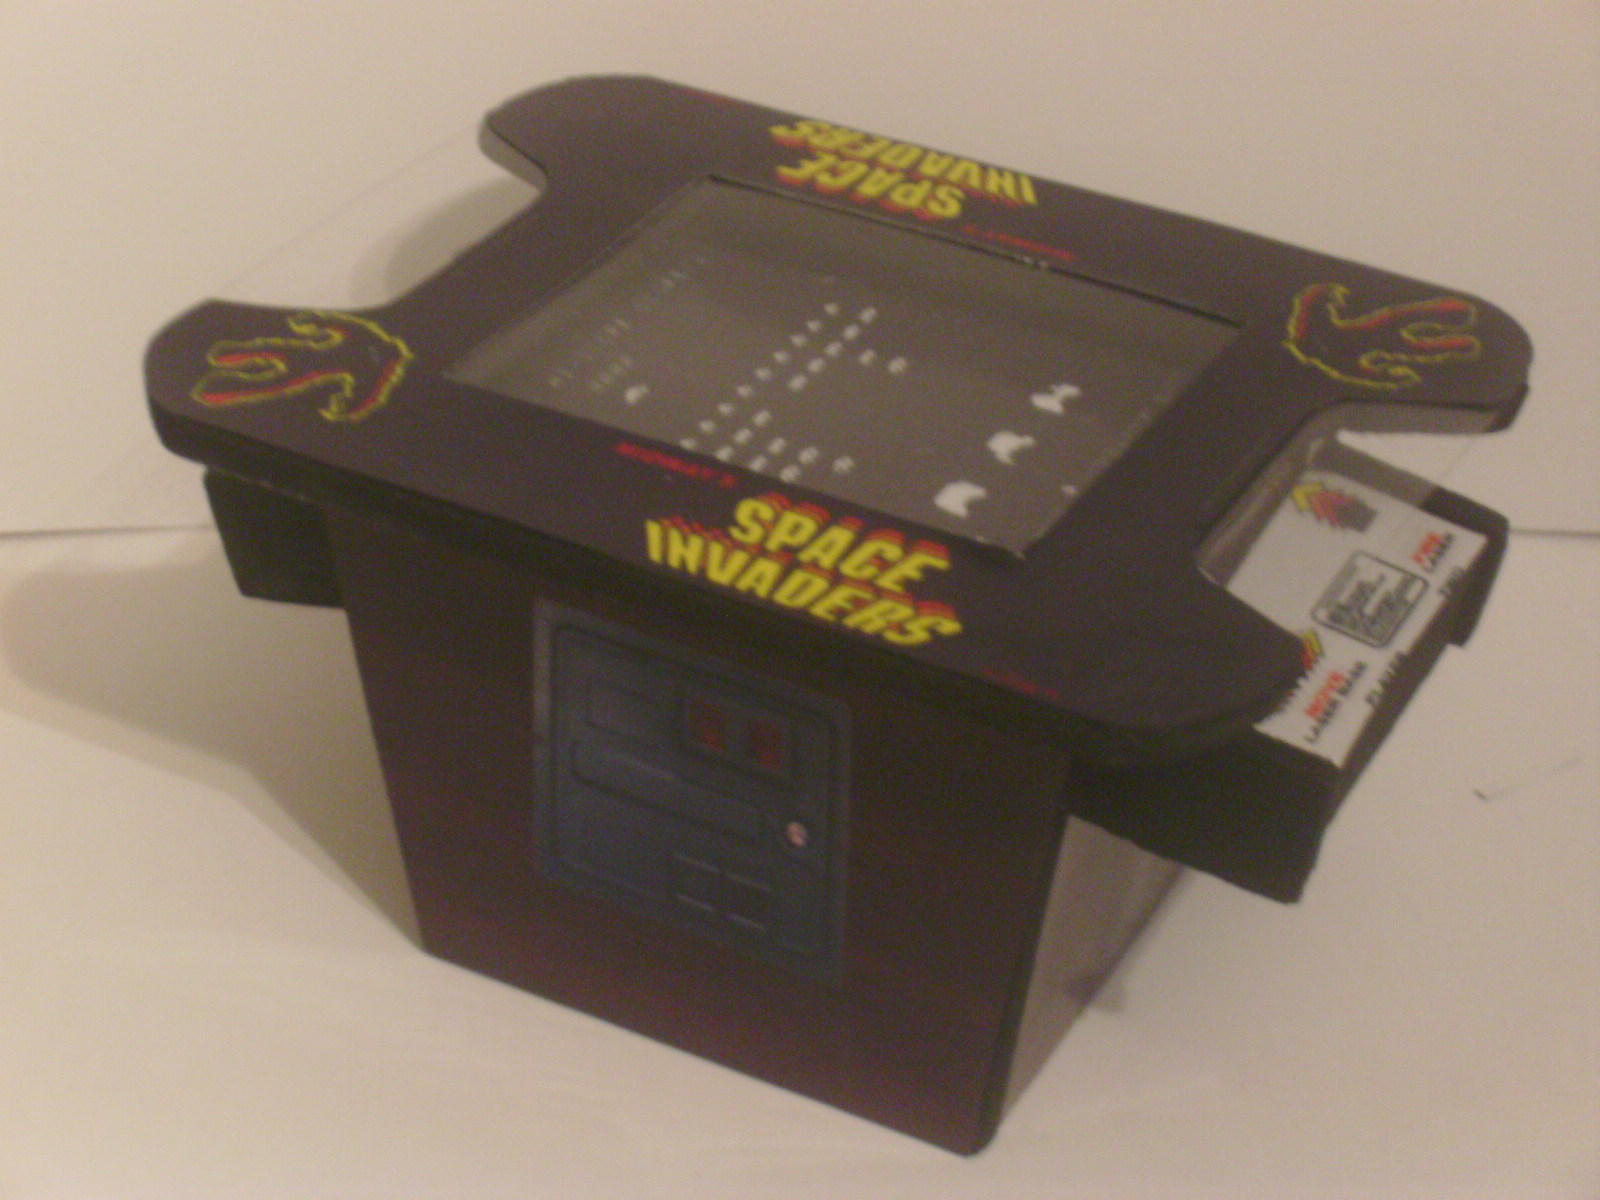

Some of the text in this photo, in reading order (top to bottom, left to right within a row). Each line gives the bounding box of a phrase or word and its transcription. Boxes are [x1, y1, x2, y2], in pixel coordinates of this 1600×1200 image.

[768, 119, 1038, 207] INVADERS
[775, 151, 966, 221] SPACE
[645, 516, 963, 645] INVADERS
[729, 493, 951, 593] SPACE
